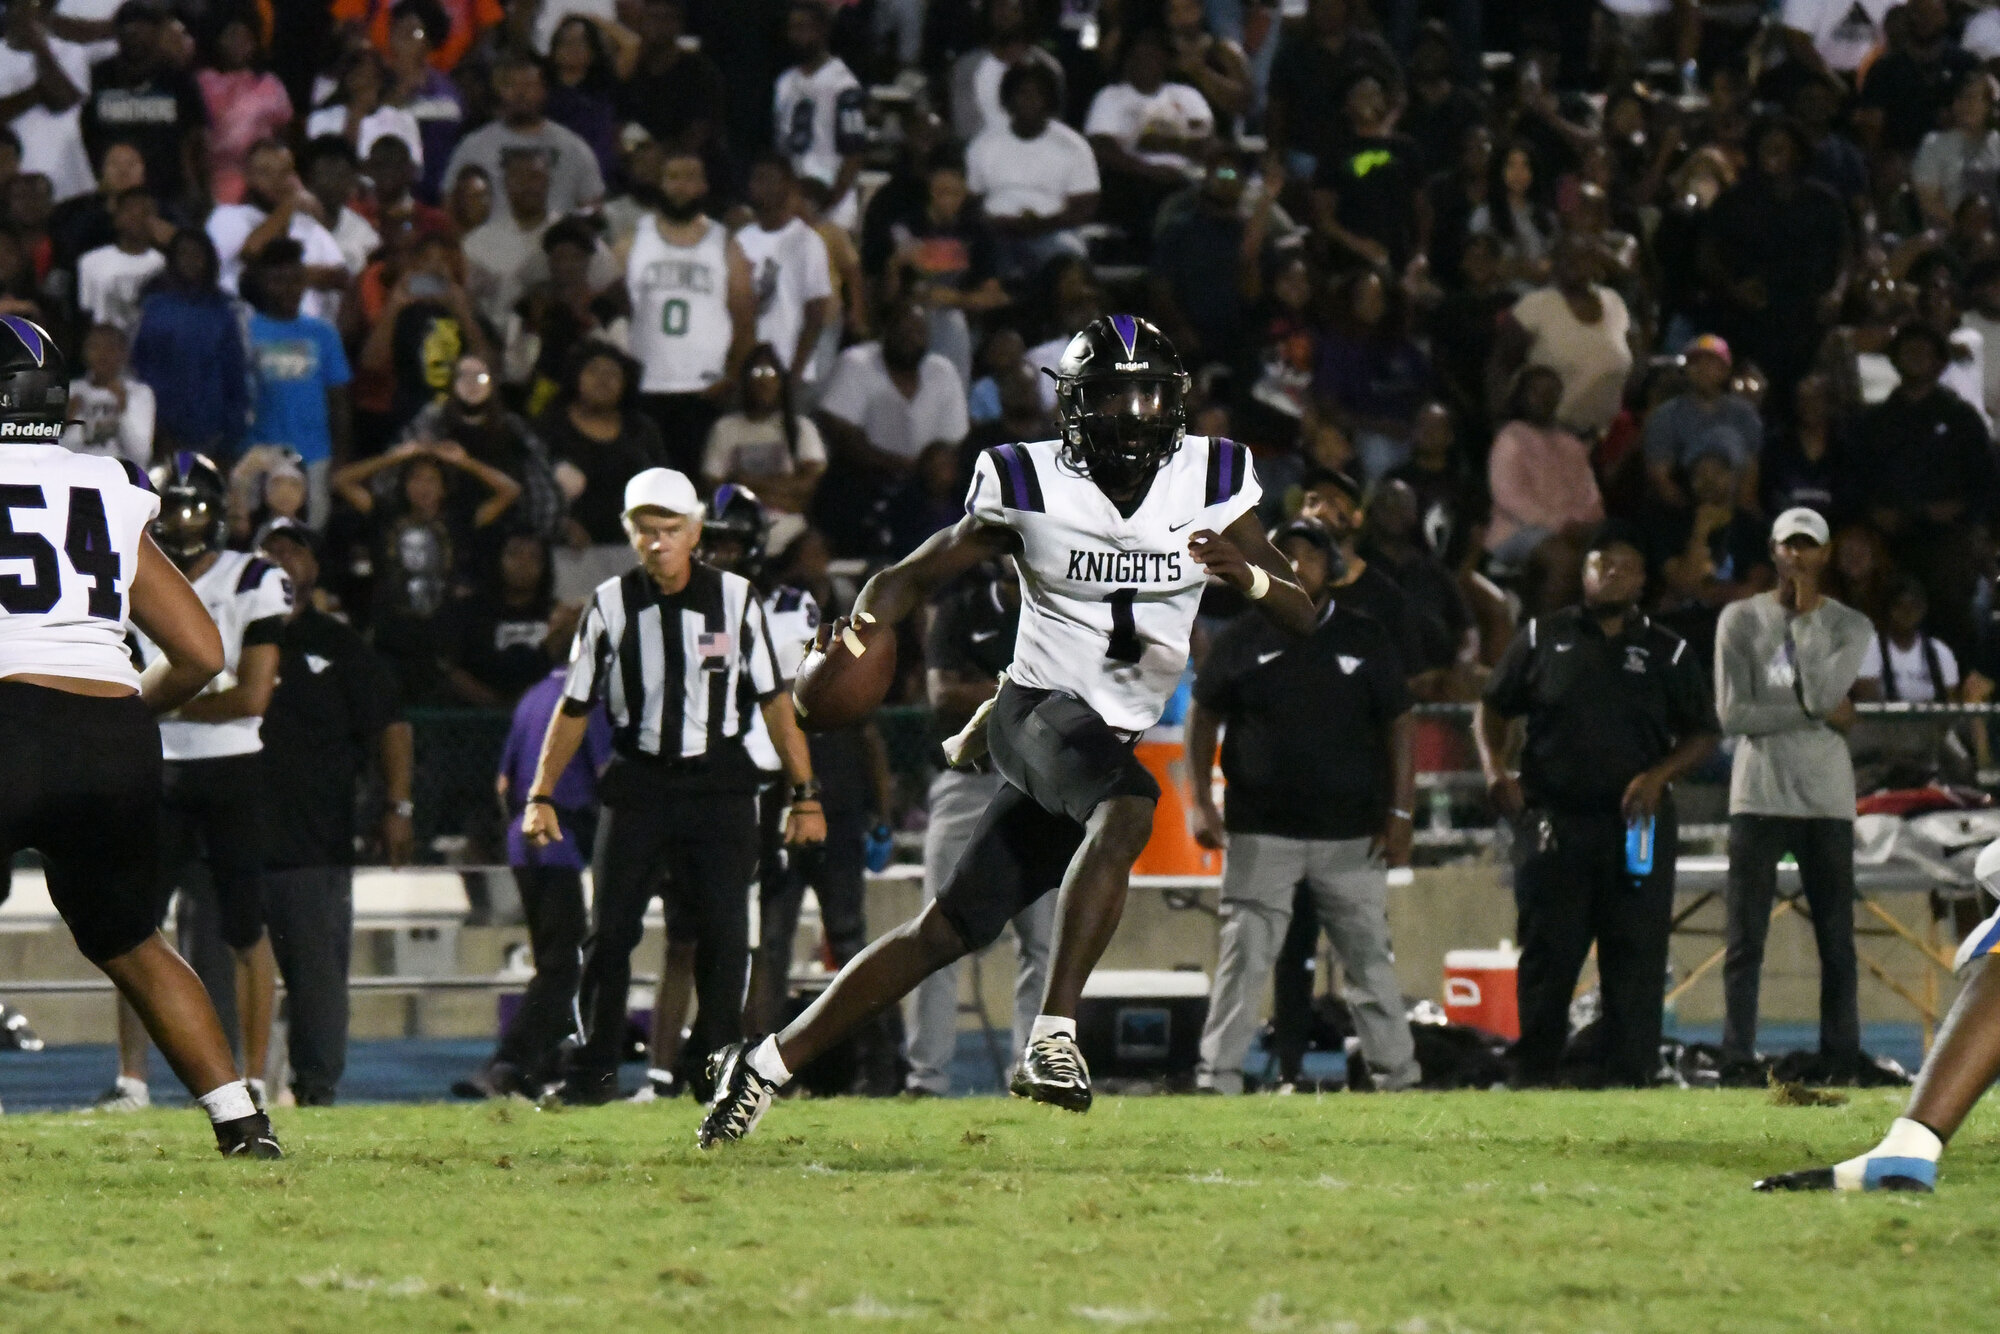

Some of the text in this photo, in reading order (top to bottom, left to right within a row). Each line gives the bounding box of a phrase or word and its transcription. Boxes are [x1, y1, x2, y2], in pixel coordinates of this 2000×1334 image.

[662, 298, 690, 336] 0
[1115, 361, 1149, 371] Riddell
[1, 422, 62, 437] Riddell
[0, 483, 122, 622] 54
[1066, 549, 1181, 583] KNIGHTS
[1102, 587, 1139, 664] 1
